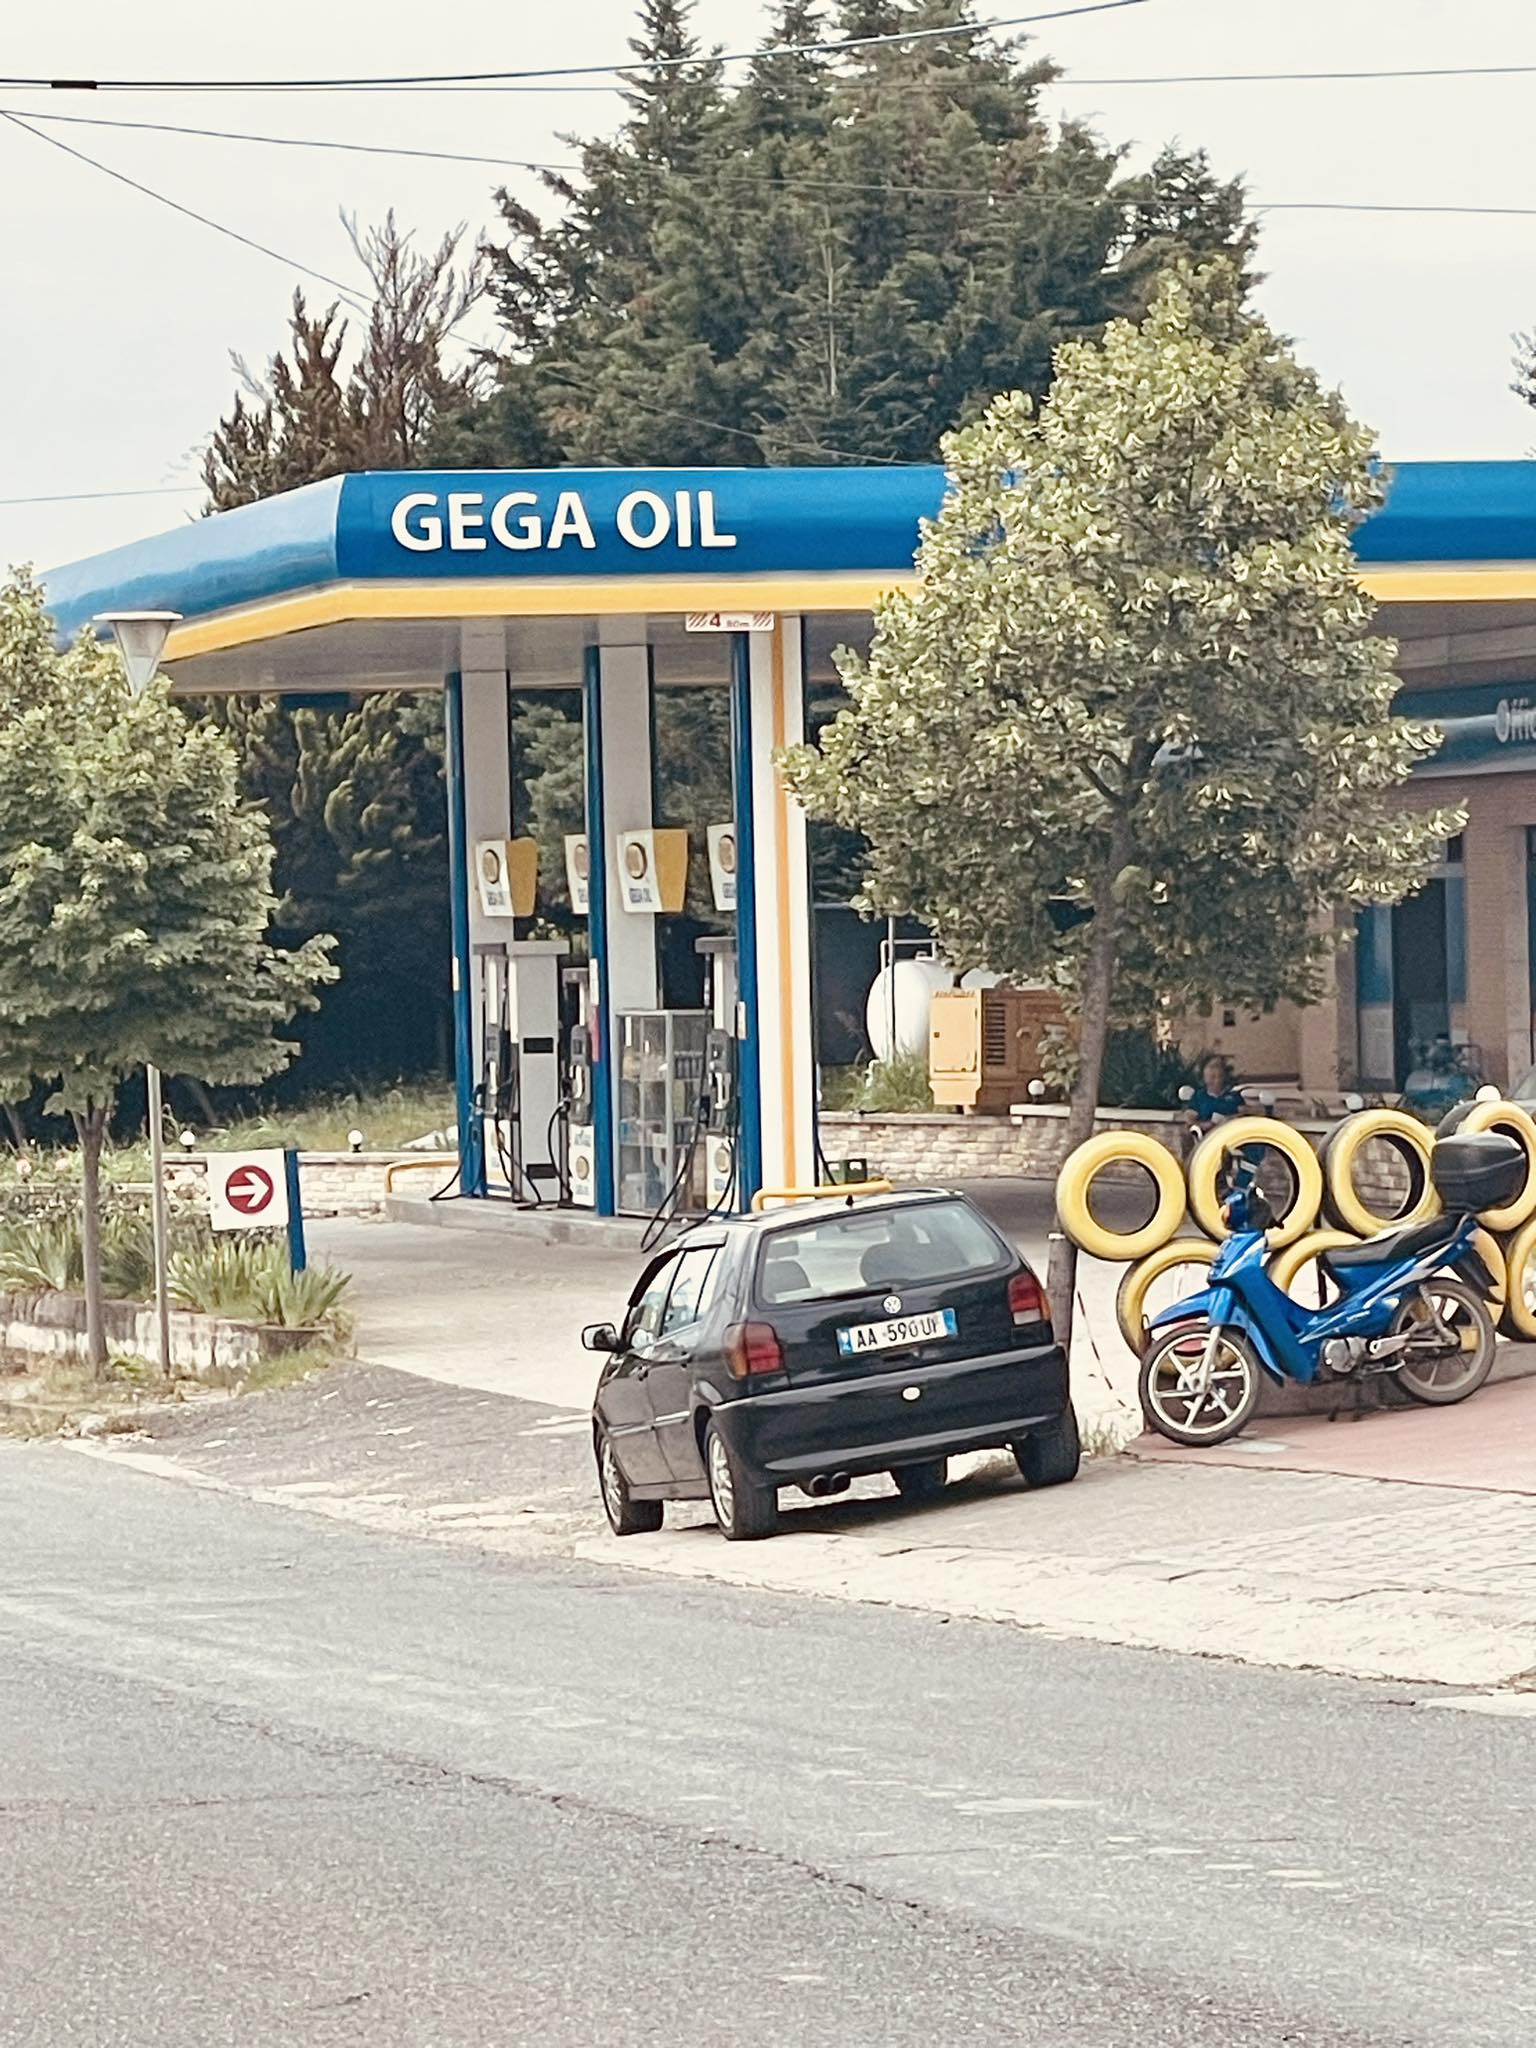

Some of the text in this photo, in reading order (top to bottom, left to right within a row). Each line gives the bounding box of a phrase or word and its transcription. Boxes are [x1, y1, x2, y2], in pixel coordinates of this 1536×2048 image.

[391, 490, 737, 551] GEGA OIL
[709, 612, 721, 627] 4
[857, 1328, 878, 1348] AA
